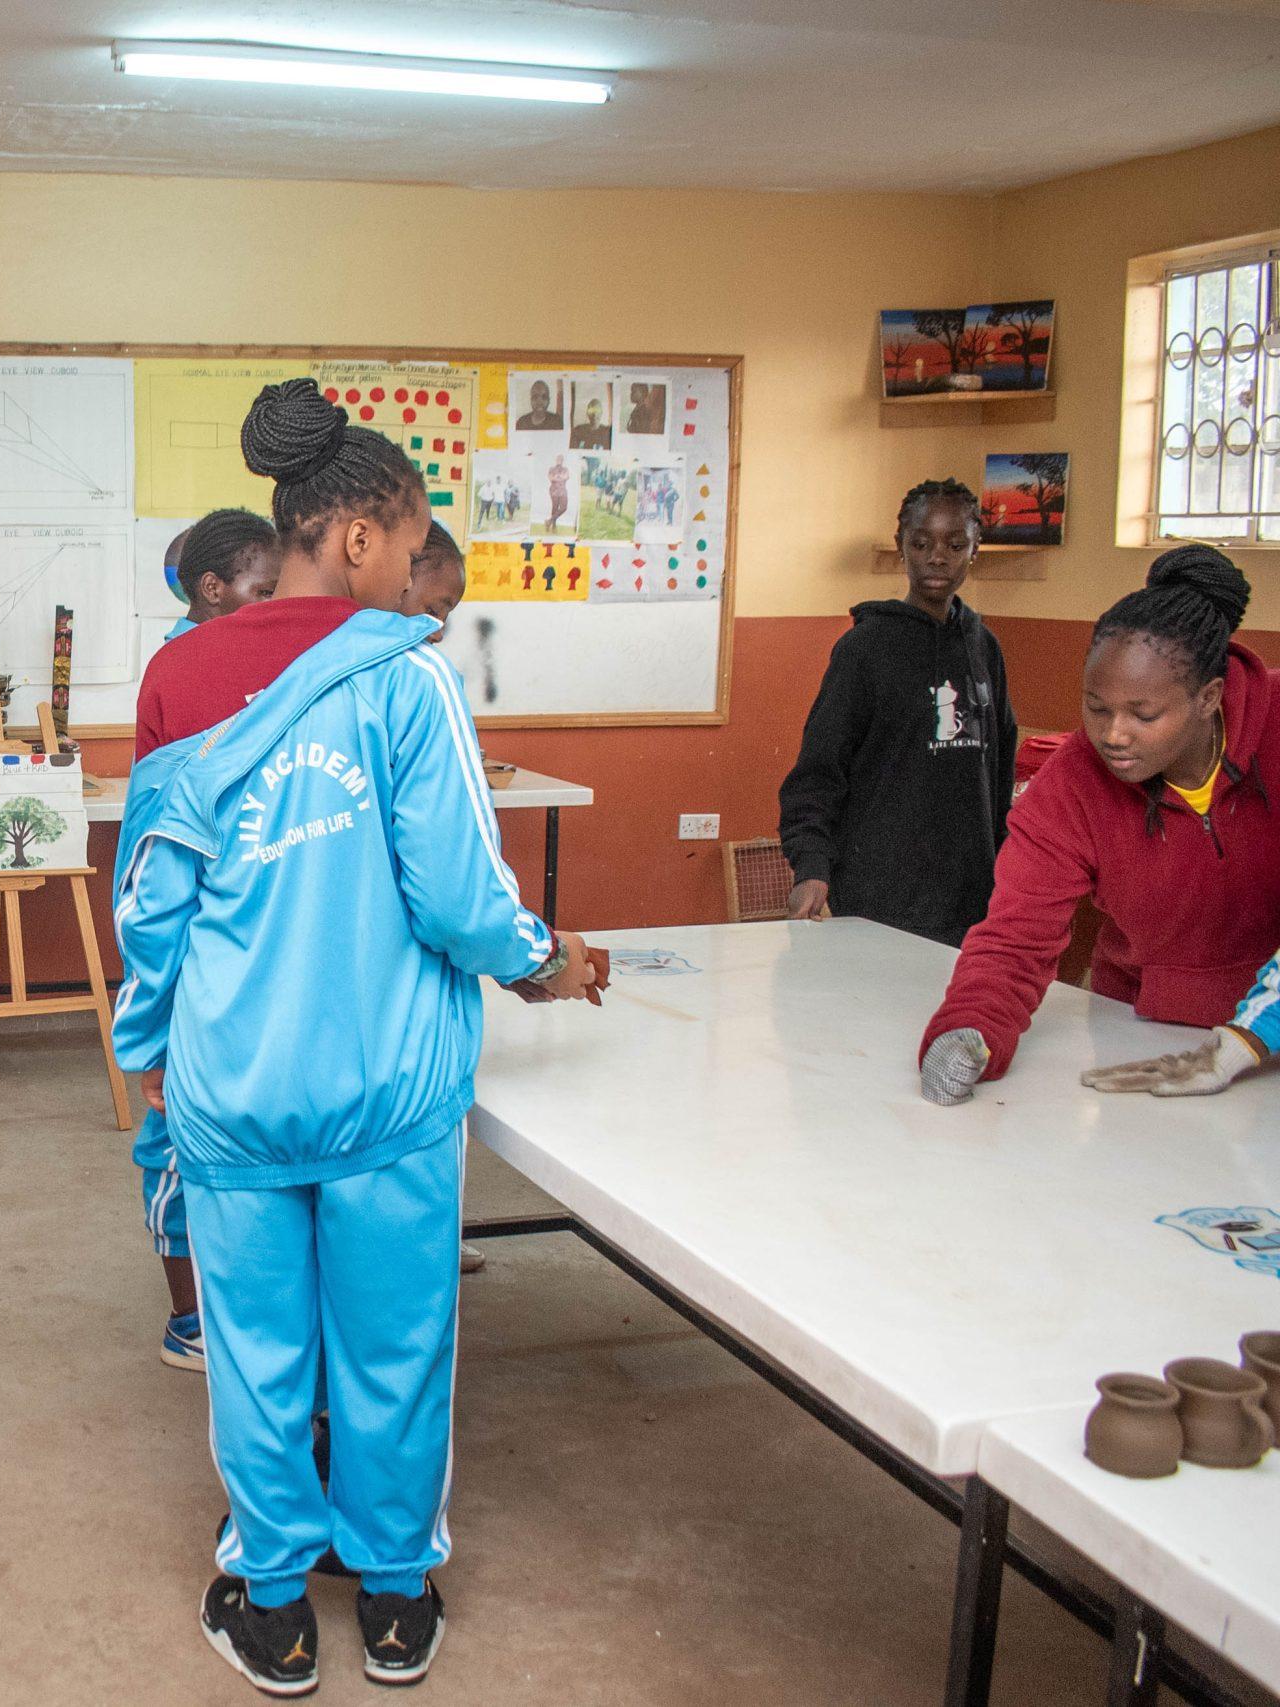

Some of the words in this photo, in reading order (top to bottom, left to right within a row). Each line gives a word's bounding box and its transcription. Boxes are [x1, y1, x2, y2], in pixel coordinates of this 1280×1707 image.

[24, 366, 45, 376] VIEW
[32, 528, 51, 538] VIEW
[239, 792, 266, 862] LILY
[306, 819, 328, 840] FOR
[327, 812, 354, 833] LIFE
